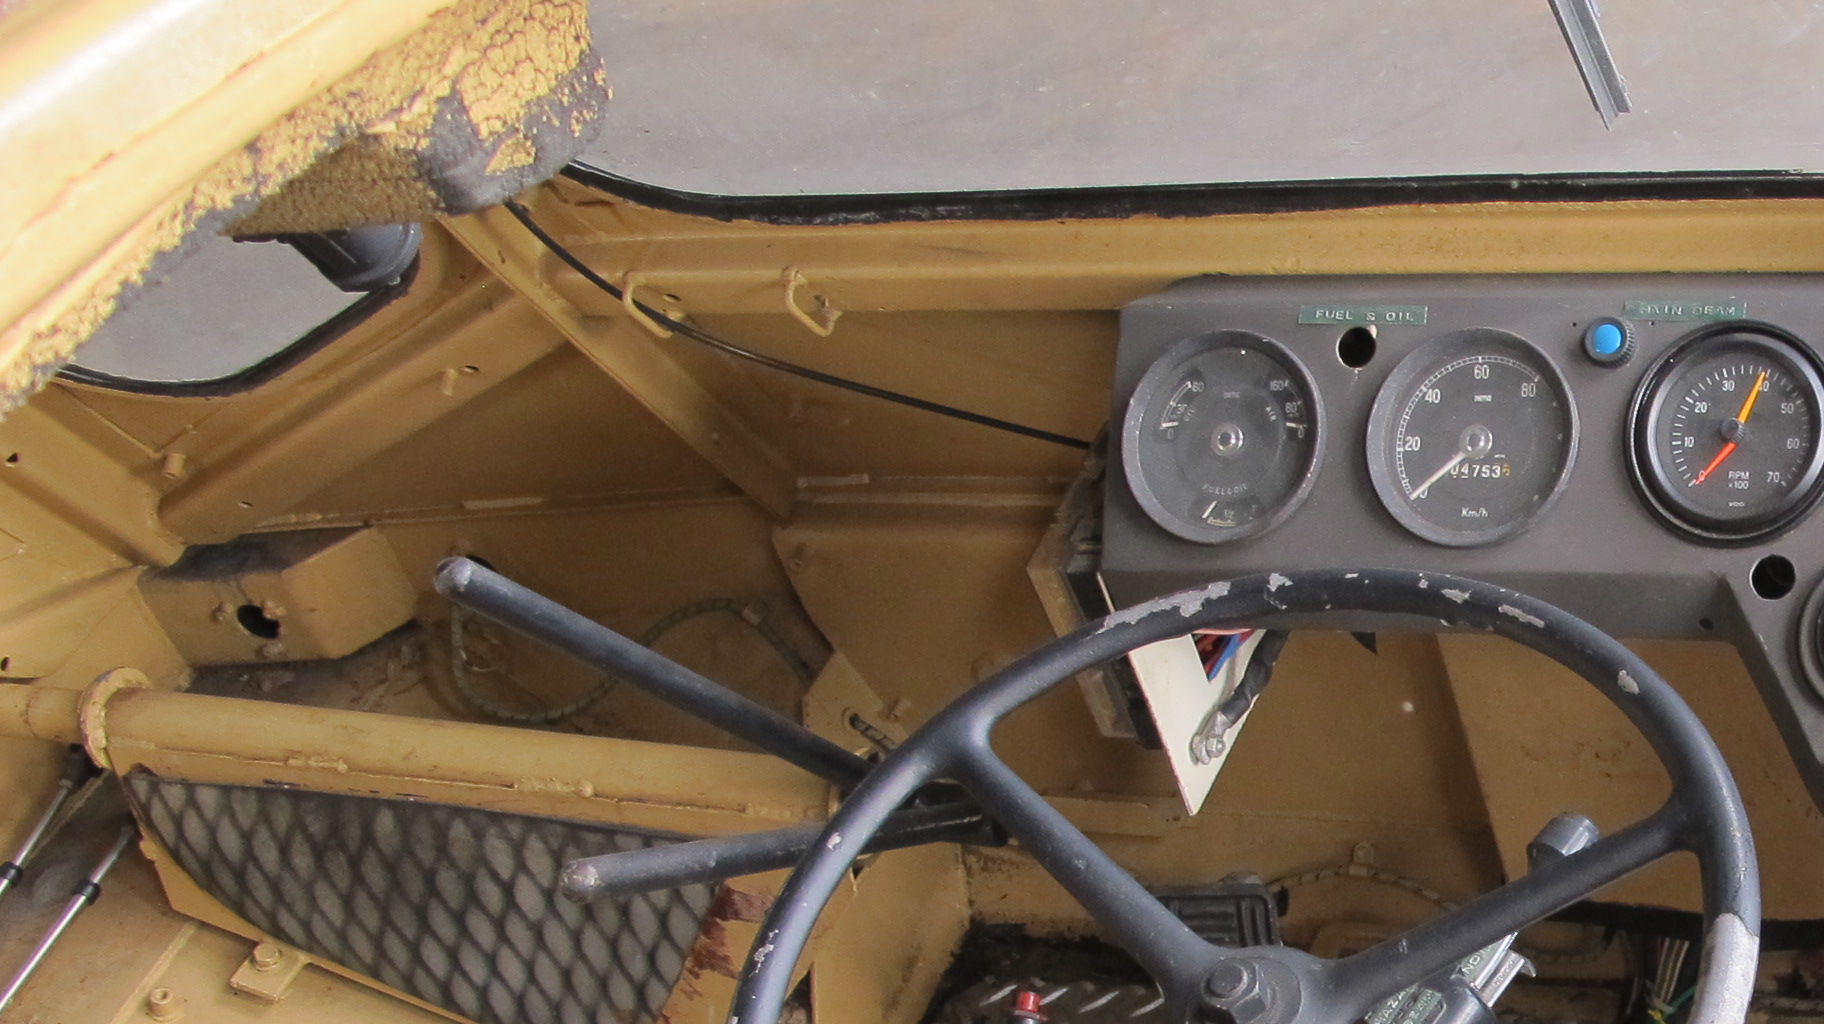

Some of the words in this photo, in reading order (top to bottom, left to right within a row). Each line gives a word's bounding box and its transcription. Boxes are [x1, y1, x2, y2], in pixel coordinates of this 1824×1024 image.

[1315, 309, 1353, 320] FUEL
[1386, 311, 1414, 322] OIL
[1474, 365, 1489, 379] 60
[1521, 383, 1536, 397] 80
[1722, 381, 1735, 392] 30
[1425, 389, 1441, 403] 40
[1694, 401, 1708, 413] 20
[1781, 403, 1794, 414] 50
[1405, 437, 1421, 451] 20
[1684, 436, 1695, 447] 10
[1787, 438, 1799, 449] 60
[1728, 471, 1749, 480] RPM
[1767, 471, 1780, 482] 70
